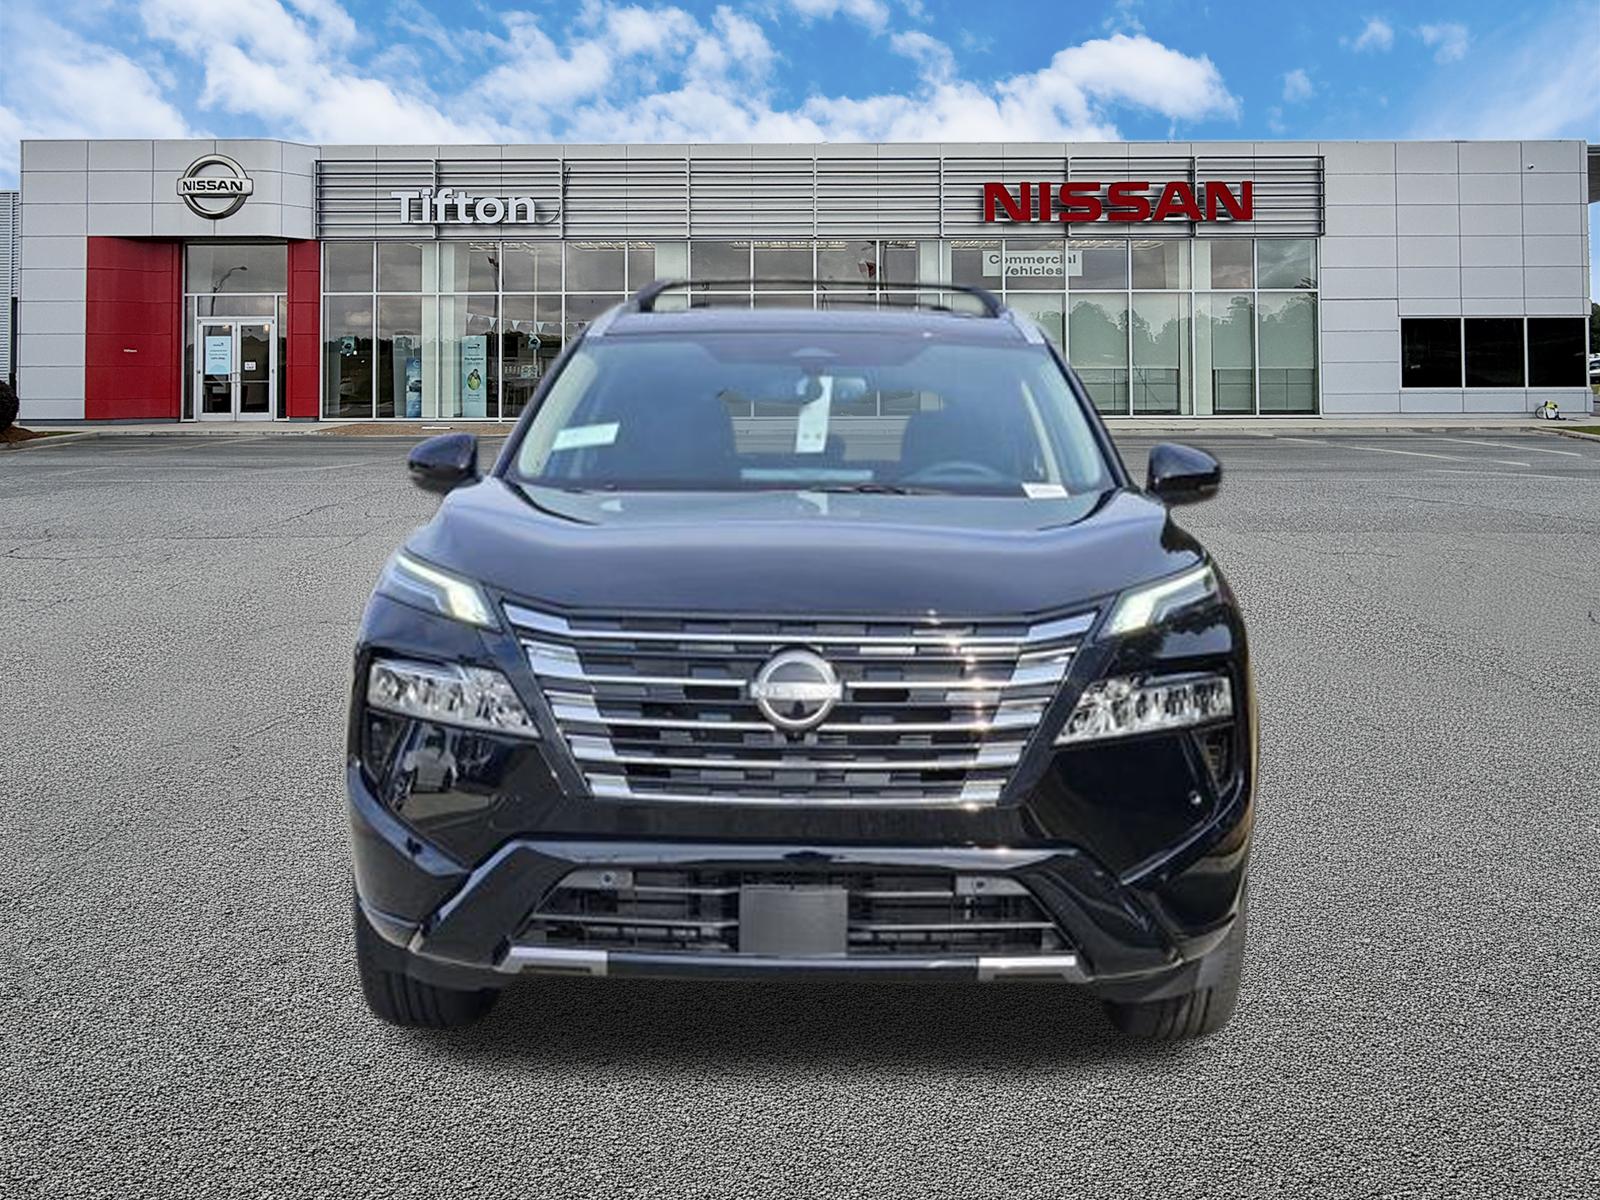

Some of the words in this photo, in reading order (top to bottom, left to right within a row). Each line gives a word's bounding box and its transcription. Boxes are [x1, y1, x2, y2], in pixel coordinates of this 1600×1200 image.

[182, 180, 243, 192] NISSAN
[983, 181, 1254, 222] NISSAN
[391, 188, 536, 224] Tifton
